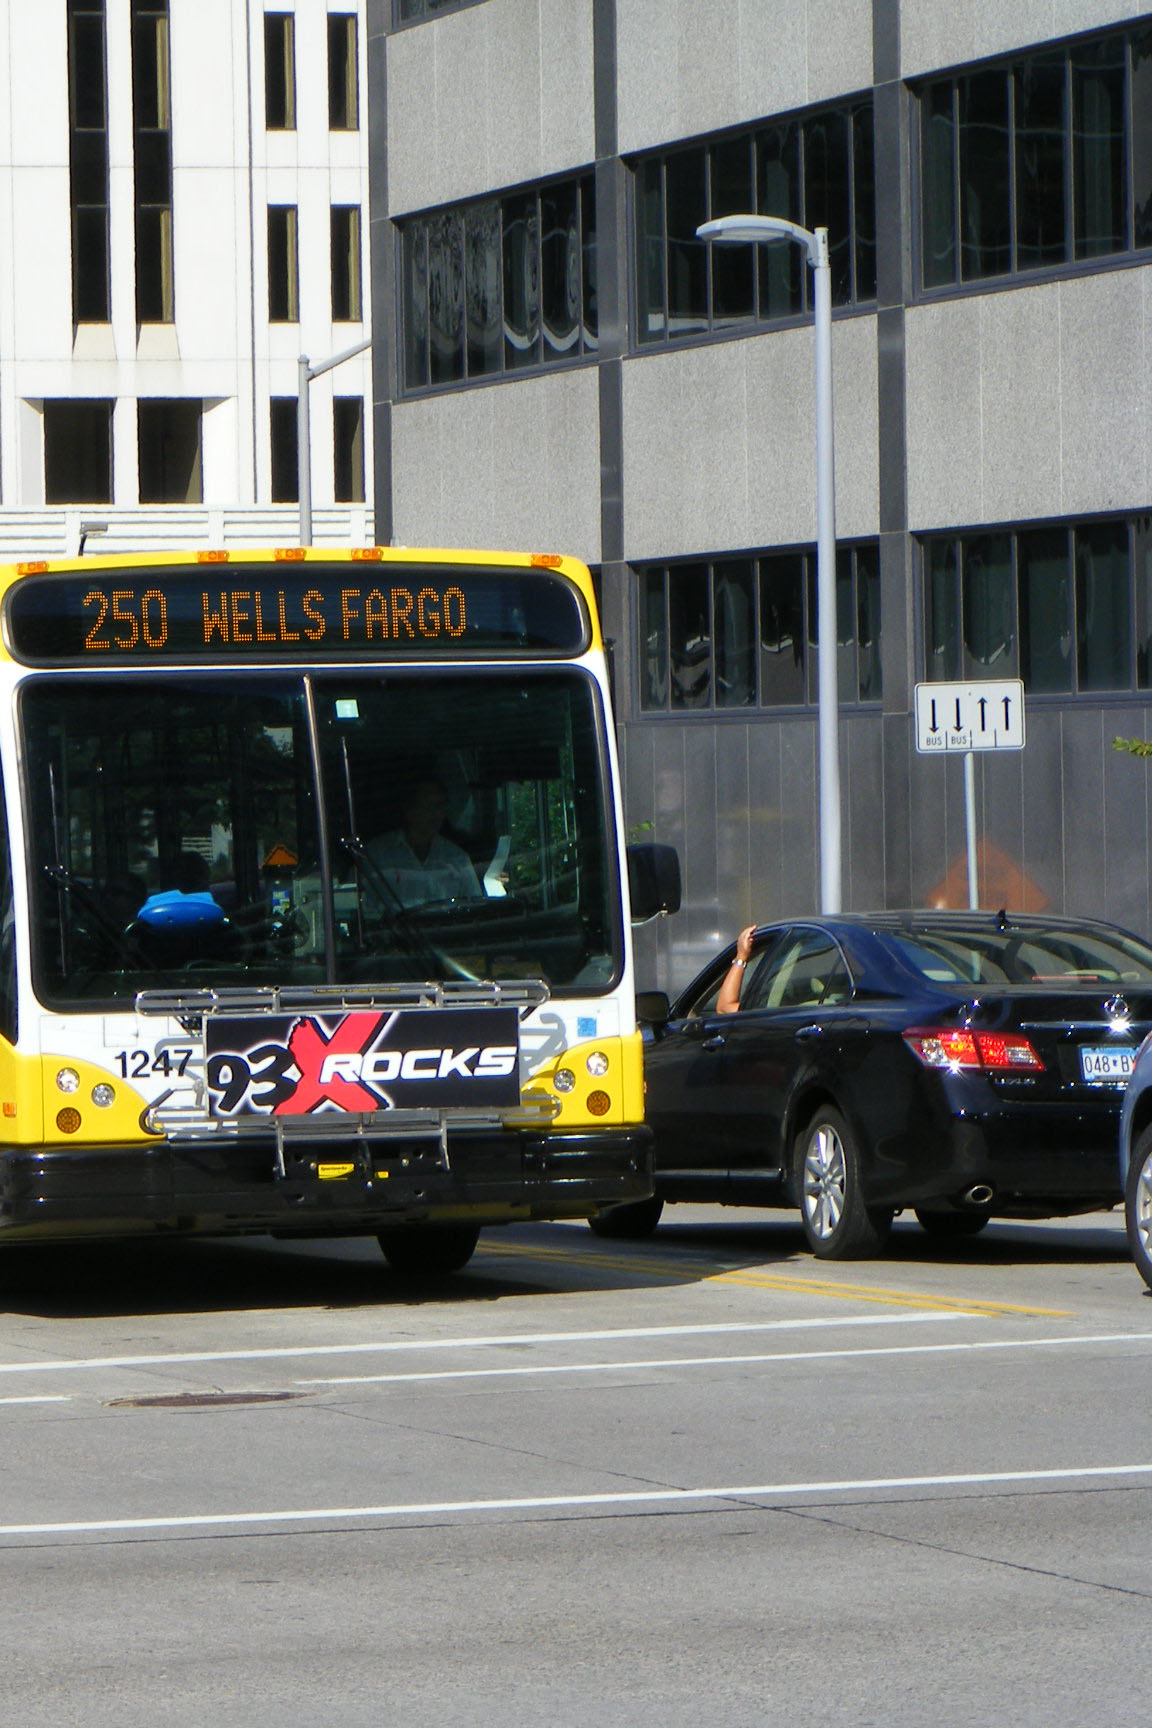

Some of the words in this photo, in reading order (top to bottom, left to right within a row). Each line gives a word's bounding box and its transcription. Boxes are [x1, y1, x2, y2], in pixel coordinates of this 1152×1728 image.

[82, 589, 168, 649] 250
[202, 589, 326, 644] WELLS
[341, 586, 467, 640] FARGO
[926, 736, 943, 746] BUS
[951, 735, 967, 745] BUS
[114, 1049, 194, 1079] 1247
[319, 1046, 517, 1084] ROCKS
[1084, 1055, 1111, 1073] 048
